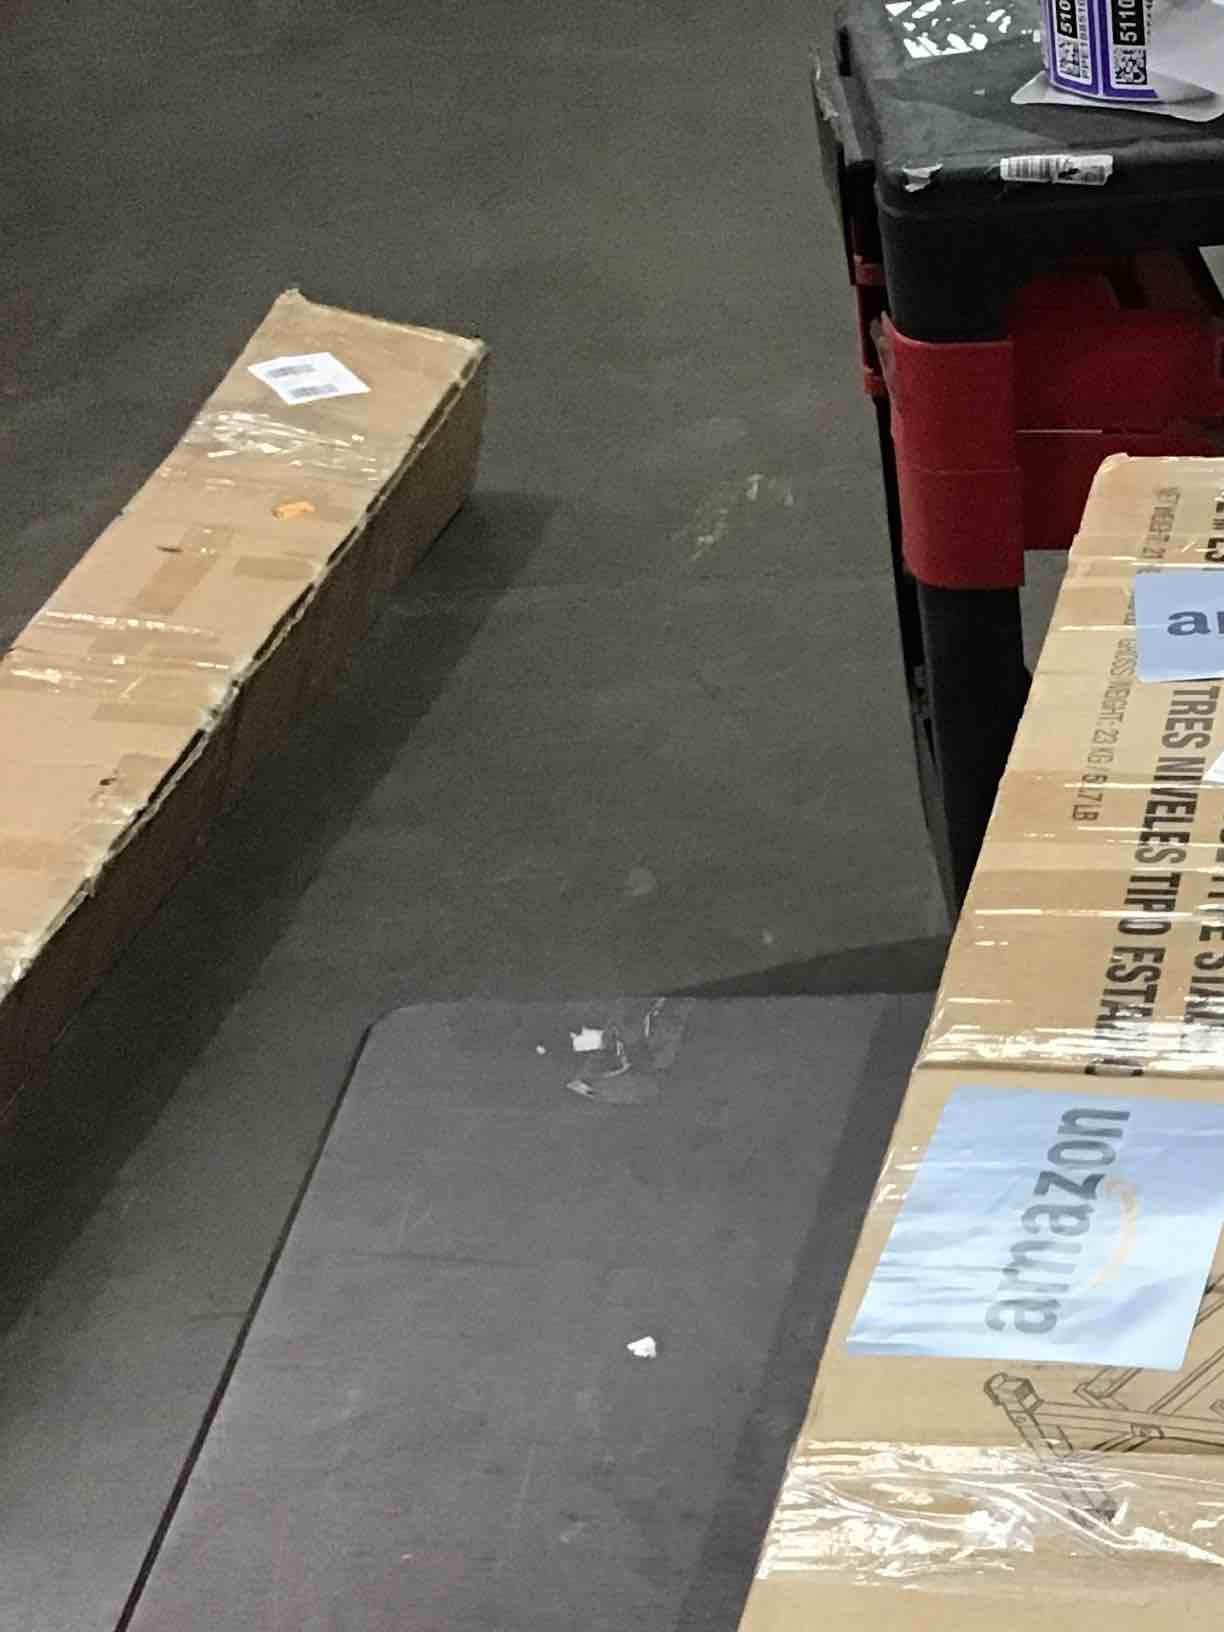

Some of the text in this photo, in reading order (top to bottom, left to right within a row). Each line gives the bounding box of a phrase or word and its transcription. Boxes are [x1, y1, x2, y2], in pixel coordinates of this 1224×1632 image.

[1161, 685, 1221, 749] TRES
[1133, 756, 1206, 864] NIVELES
[1117, 871, 1182, 936] TIPO
[985, 1106, 1131, 1334] amazon
